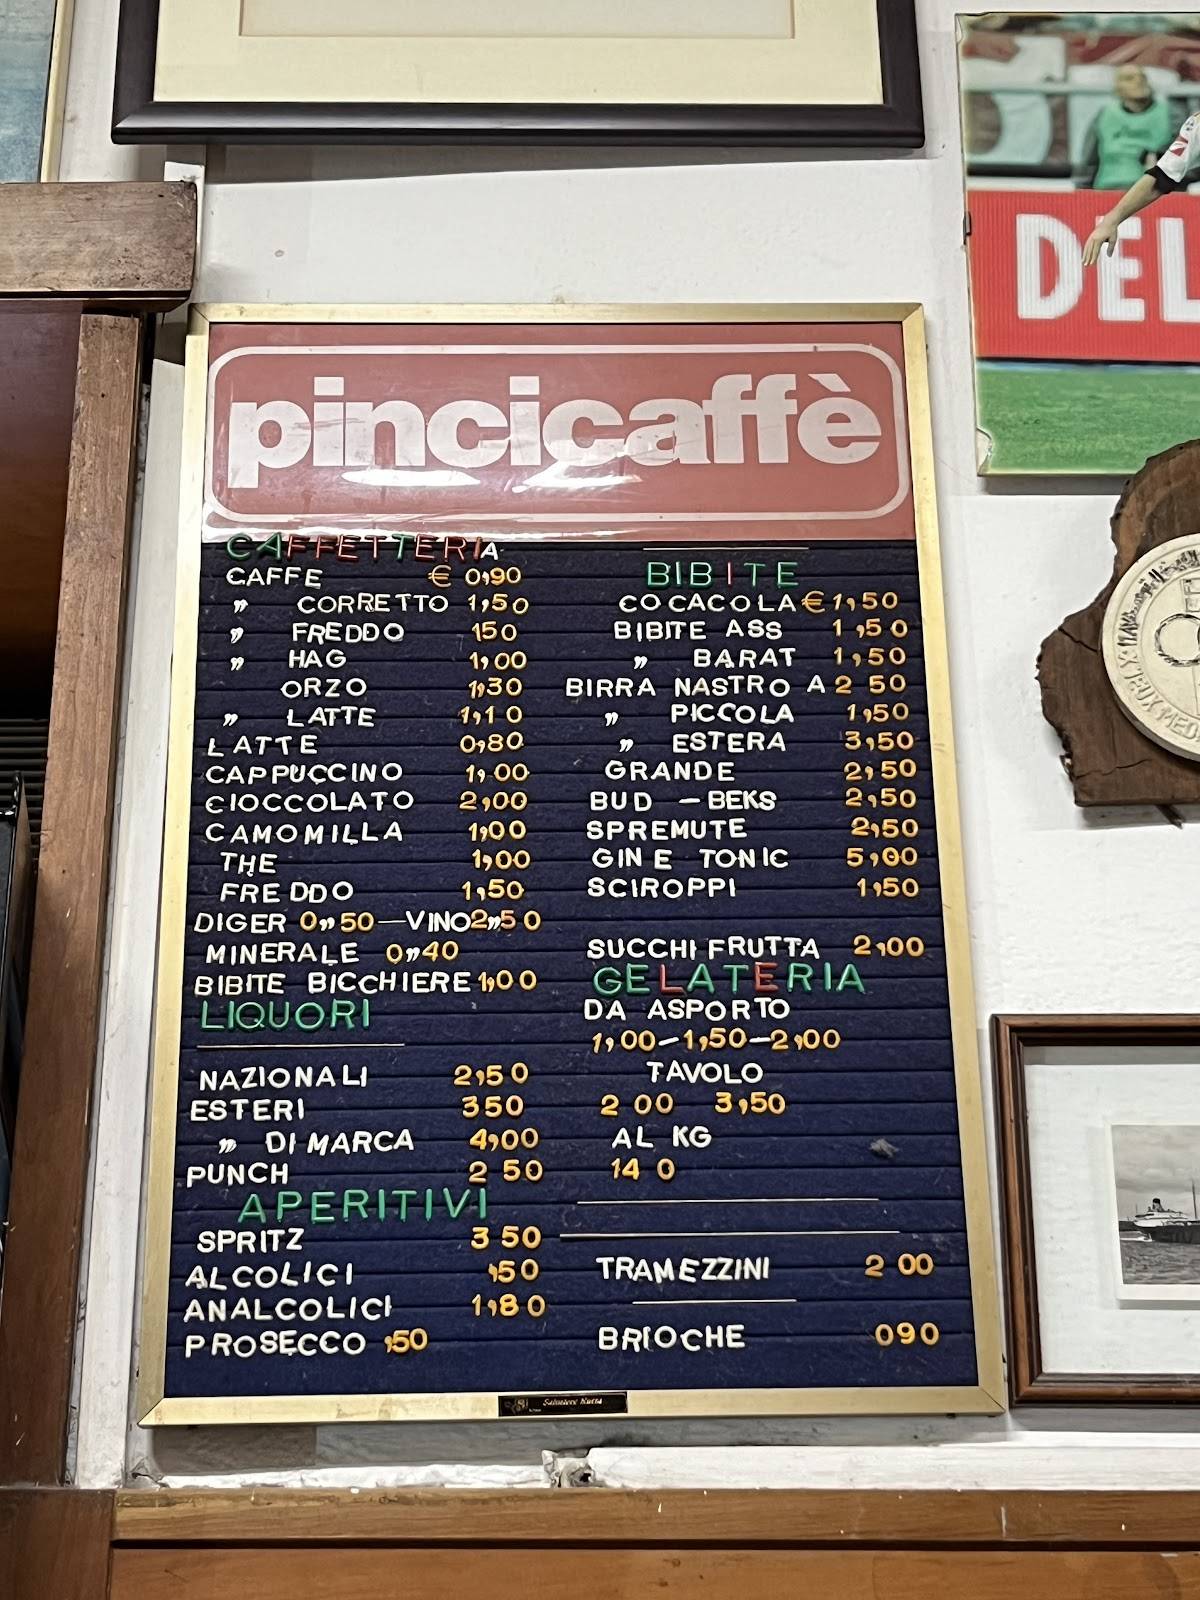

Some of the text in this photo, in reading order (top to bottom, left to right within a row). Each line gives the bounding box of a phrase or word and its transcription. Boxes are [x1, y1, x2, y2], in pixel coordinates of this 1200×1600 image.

[227, 373, 882, 490] pincicaffè
[226, 532, 499, 562] CAFFETTERIA
[226, 567, 322, 587] CAFFE
[465, 567, 521, 586] 0,90
[648, 562, 797, 586] BIBITE
[298, 593, 448, 613] CORRETTO
[468, 593, 528, 614] 1,50
[833, 592, 897, 610] 1,50
[293, 622, 404, 644] FREDDO
[472, 621, 517, 641] 150
[614, 618, 908, 641] BIBITE ASS 1,50
[289, 650, 346, 668] HAG
[470, 651, 527, 670] 1,00
[694, 648, 795, 668] BARAT
[834, 647, 906, 667] 1,50
[281, 677, 522, 698] ORZO 1,30
[566, 678, 655, 697] BIRRA
[675, 675, 790, 697] NASTRO
[807, 675, 825, 693] A
[287, 706, 376, 727] LATTE
[461, 706, 522, 724] 1,10
[672, 703, 794, 724] PICCOLA
[848, 703, 909, 722] 1,50
[208, 731, 524, 756] LATTE 0,80
[673, 731, 785, 753] ESTERA
[845, 731, 914, 751] 3,50
[206, 763, 529, 784] CAPPUCCINO 1,00
[605, 759, 916, 781] GRANDE 2,50
[206, 791, 527, 813] CIOCCOLATO 2,00
[591, 792, 652, 811] BUD
[708, 790, 776, 810] BEKS
[846, 787, 916, 808] 2,50
[206, 820, 526, 845] CAMOMILLA 1,00
[587, 817, 918, 840] SPREMUTE 2,50
[221, 849, 530, 876] THE 1,00
[847, 847, 917, 867] 5,00
[221, 879, 524, 903] FREDDO 1,50
[588, 877, 919, 898] SCIROPPI 1,50
[194, 913, 286, 933] DIGER
[206, 942, 359, 966] MINERALE
[587, 935, 924, 960] SUCCHI FRUTTA 2,00
[195, 970, 536, 995] BIBITE BICCHIERE 1,00
[594, 962, 864, 994] GELATERIA
[202, 999, 369, 1028] LIQUORI
[585, 998, 789, 1021] DA ASPORTO
[200, 1063, 528, 1090] NAZIONALI 2,50
[647, 1060, 763, 1083] TAVOLO
[191, 1095, 523, 1121] ESTERI 350
[715, 1092, 785, 1115] 3,50
[266, 1131, 296, 1154] DI
[307, 1129, 414, 1155] MARCA
[470, 1128, 538, 1151] 4,00
[612, 1126, 711, 1148] AL KG
[187, 1163, 288, 1187] PUNCH
[239, 1188, 485, 1222] APERITIVI
[197, 1228, 304, 1253] SPRITZ
[185, 1261, 352, 1290] ALCOLICI
[596, 1257, 769, 1283] TRAMEZZINI
[184, 1294, 545, 1322] ANALCOLICI 1,80
[186, 1330, 365, 1357] PROSECCO
[599, 1322, 939, 1352] BRIOCHE 090
